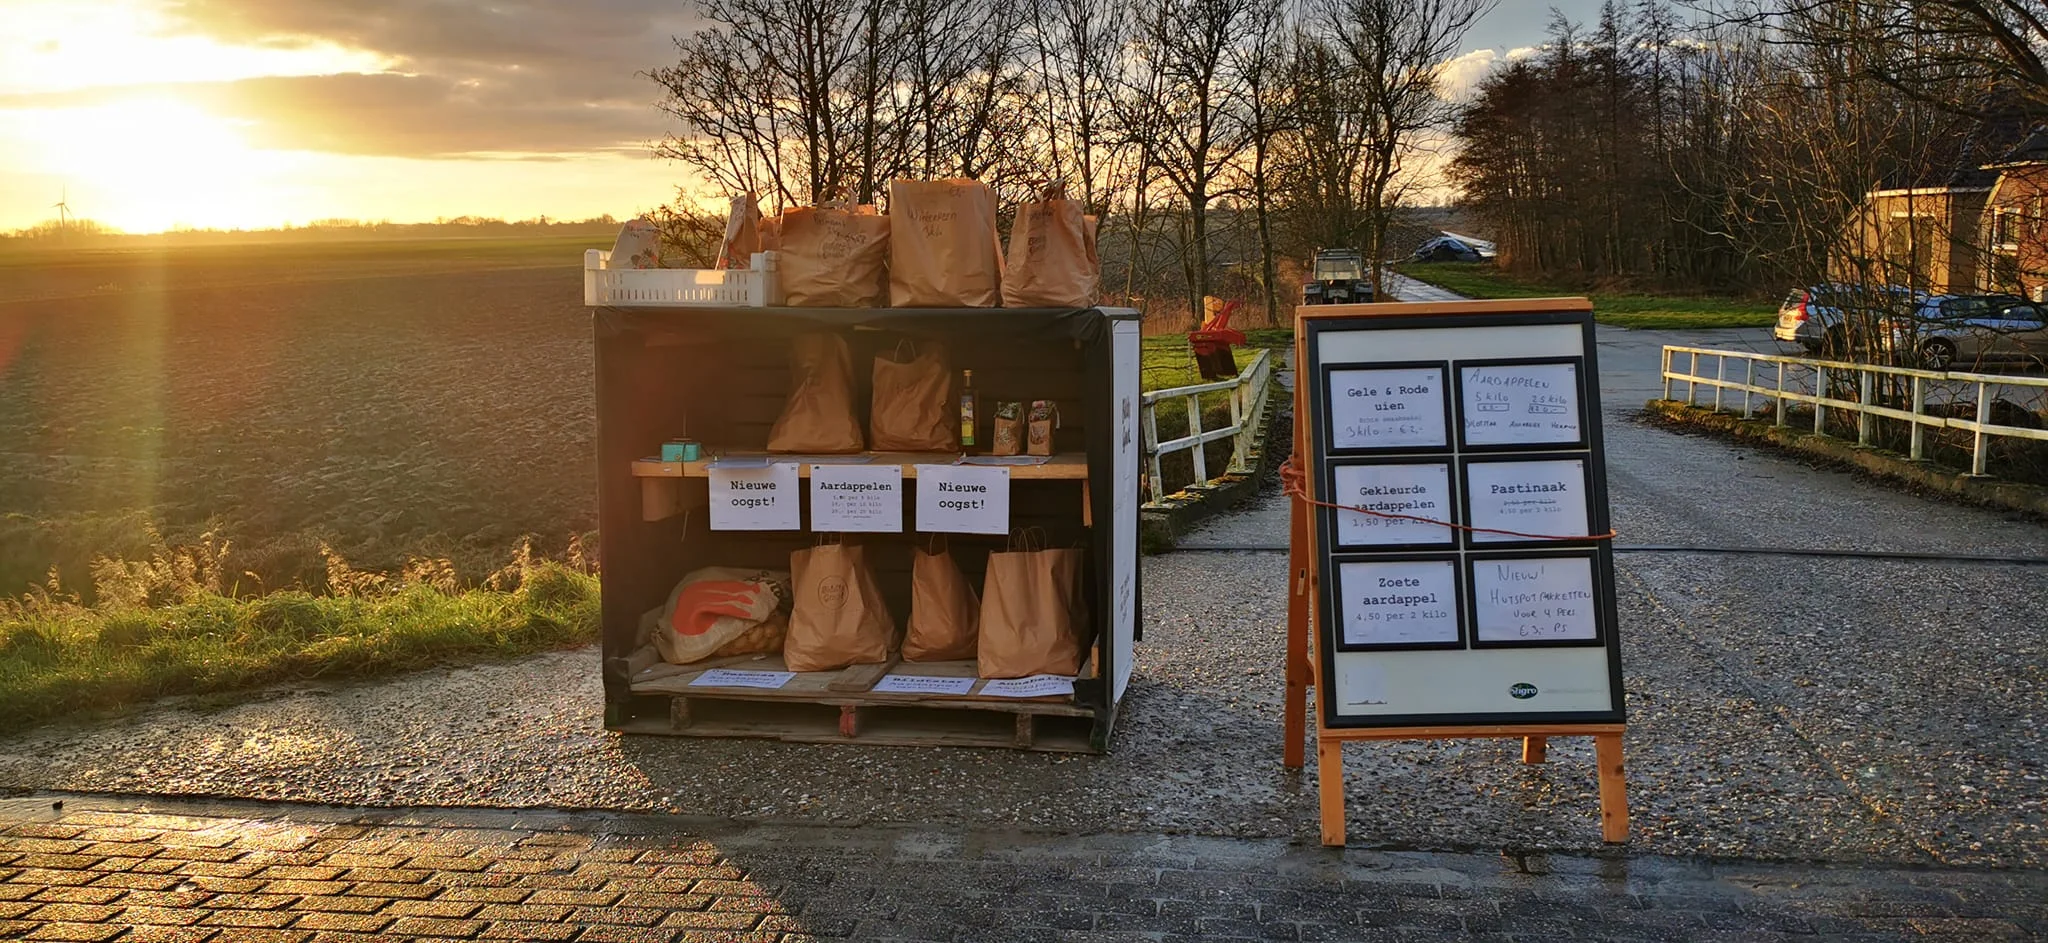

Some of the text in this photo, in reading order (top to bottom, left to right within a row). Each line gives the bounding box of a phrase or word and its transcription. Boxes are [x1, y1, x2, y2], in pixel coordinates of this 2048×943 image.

[1347, 385, 1429, 397] Gele & Rode
[1374, 402, 1405, 411] uien
[730, 480, 776, 490] Nieuwe
[820, 481, 892, 492] Aardappelen
[939, 481, 987, 493] Nieuwe
[1360, 484, 1426, 496] Gekleurde
[1491, 481, 1567, 494] Pastinaak
[731, 496, 775, 509] oogst!
[939, 499, 985, 511] oogst!
[1354, 500, 1435, 512] aardappelen
[1353, 518, 1379, 527] 1,50
[1385, 517, 1405, 528] per
[1378, 577, 1420, 588] Zoete
[1363, 593, 1438, 607] aardappel
[1356, 610, 1447, 622] 4,50 per 2 kilo
[1544, 608, 1551, 618] 4
